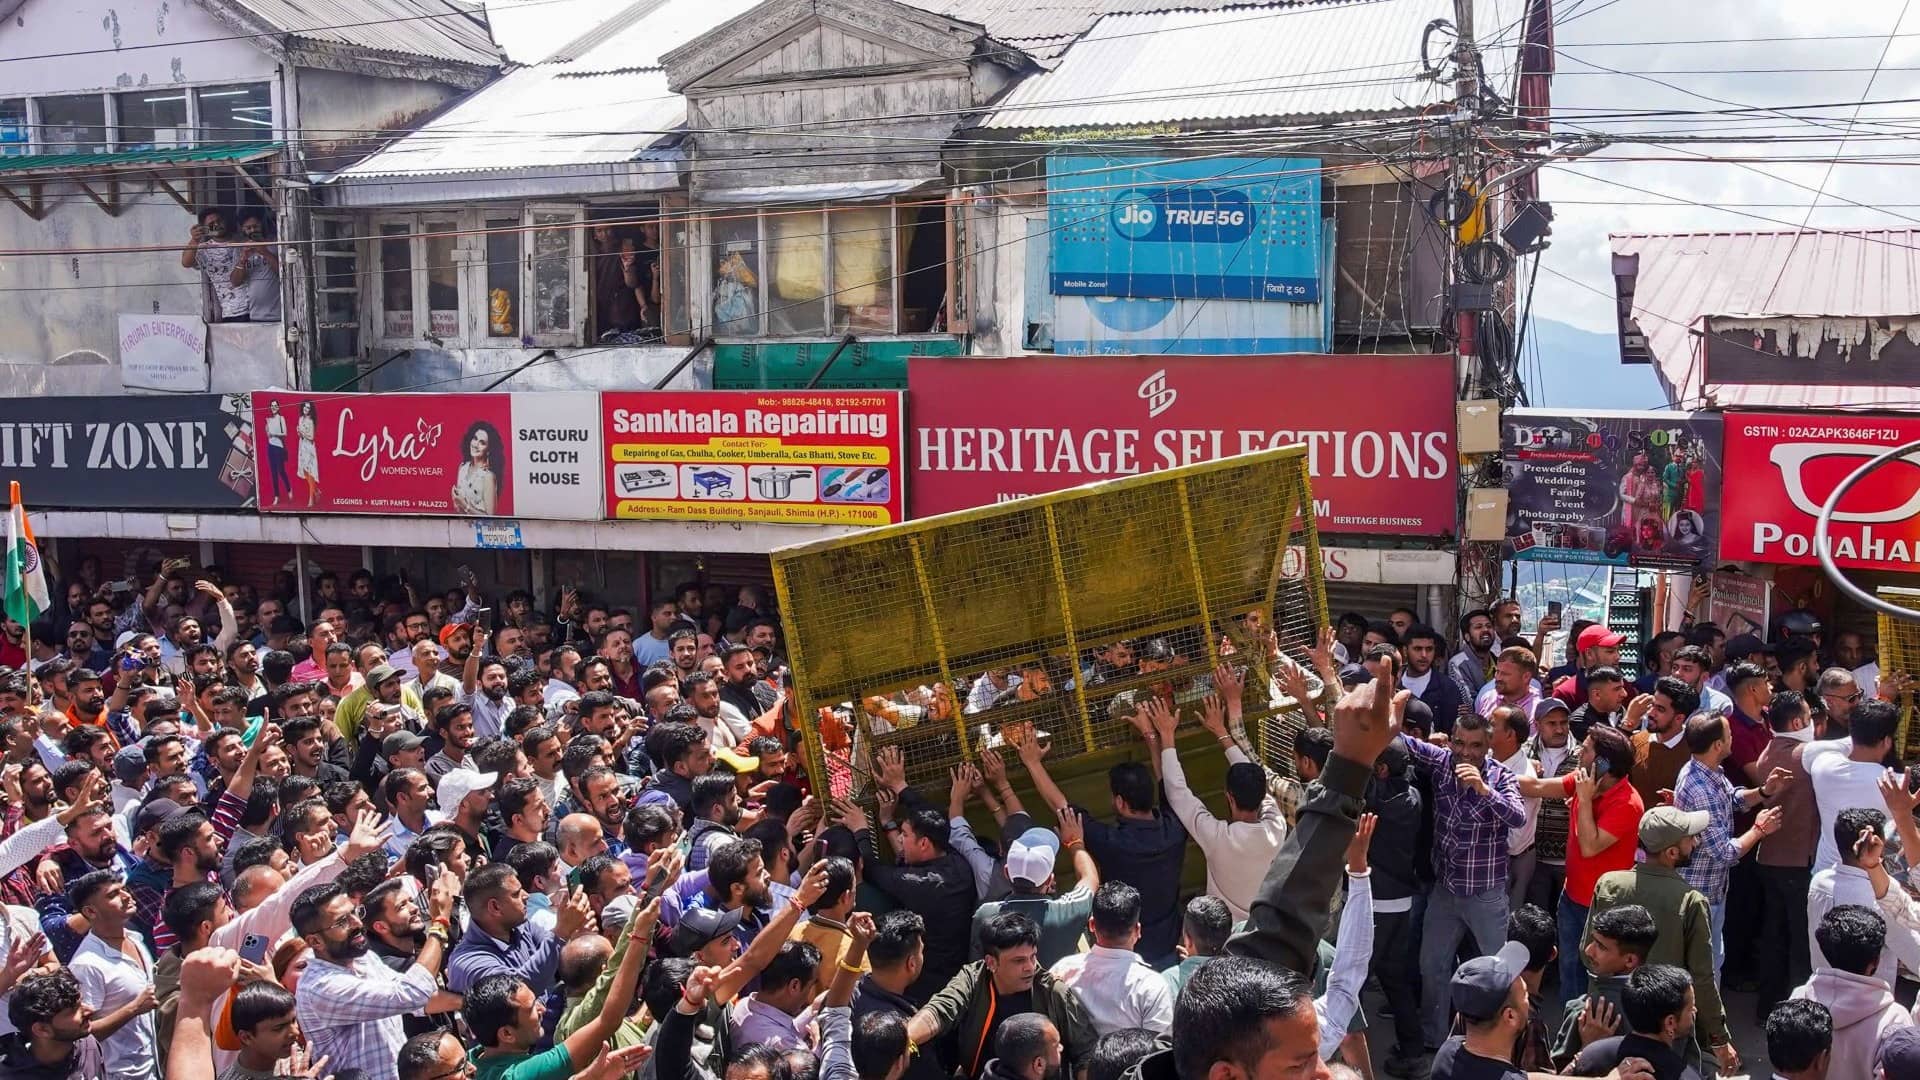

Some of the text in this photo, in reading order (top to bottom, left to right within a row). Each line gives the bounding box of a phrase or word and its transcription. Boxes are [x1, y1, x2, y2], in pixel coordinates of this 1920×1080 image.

[1119, 204, 1245, 226] Jio TRUE 5G
[1063, 280, 1087, 288] Mobile
[1294, 286, 1306, 294] 5G
[122, 320, 204, 354] TIRUPATI ENTERPRISES
[613, 409, 887, 437] Sankhala Repairing
[519, 429, 588, 442] SATGURU
[1743, 426, 1779, 437] GSTIN
[1788, 427, 1899, 440] 02AZAPK3646F1ZU
[86, 422, 209, 469] ZONE
[332, 408, 425, 481] Lyra
[722, 440, 748, 448] Contact
[529, 450, 578, 463] CLOTH
[623, 448, 660, 458] Repairing
[661, 449, 669, 457] of
[670, 449, 686, 458] Gas,
[716, 450, 746, 459] Cooker,
[747, 450, 791, 459] Umberalla,
[792, 451, 807, 459] Gas
[809, 451, 837, 460] Bhatti,
[838, 451, 860, 460] Stove
[862, 452, 877, 460] Etc.
[918, 428, 1140, 474] HERITAGE
[381, 466, 443, 476] WOMEN'S WEAR
[1523, 463, 1586, 476] Prewedding
[529, 472, 580, 485] HOUSE
[1534, 475, 1586, 487] Weddings
[1550, 487, 1586, 499] Family
[1554, 499, 1585, 509] Event
[667, 505, 685, 514] Ram
[687, 506, 707, 514] Dass
[709, 507, 746, 517] Building,
[785, 508, 815, 518] Shimla
[817, 509, 840, 518] (H.P.)
[847, 510, 878, 519] 171006
[1518, 509, 1585, 521] Photography
[1333, 516, 1423, 527] HERITAGE BUSINESS
